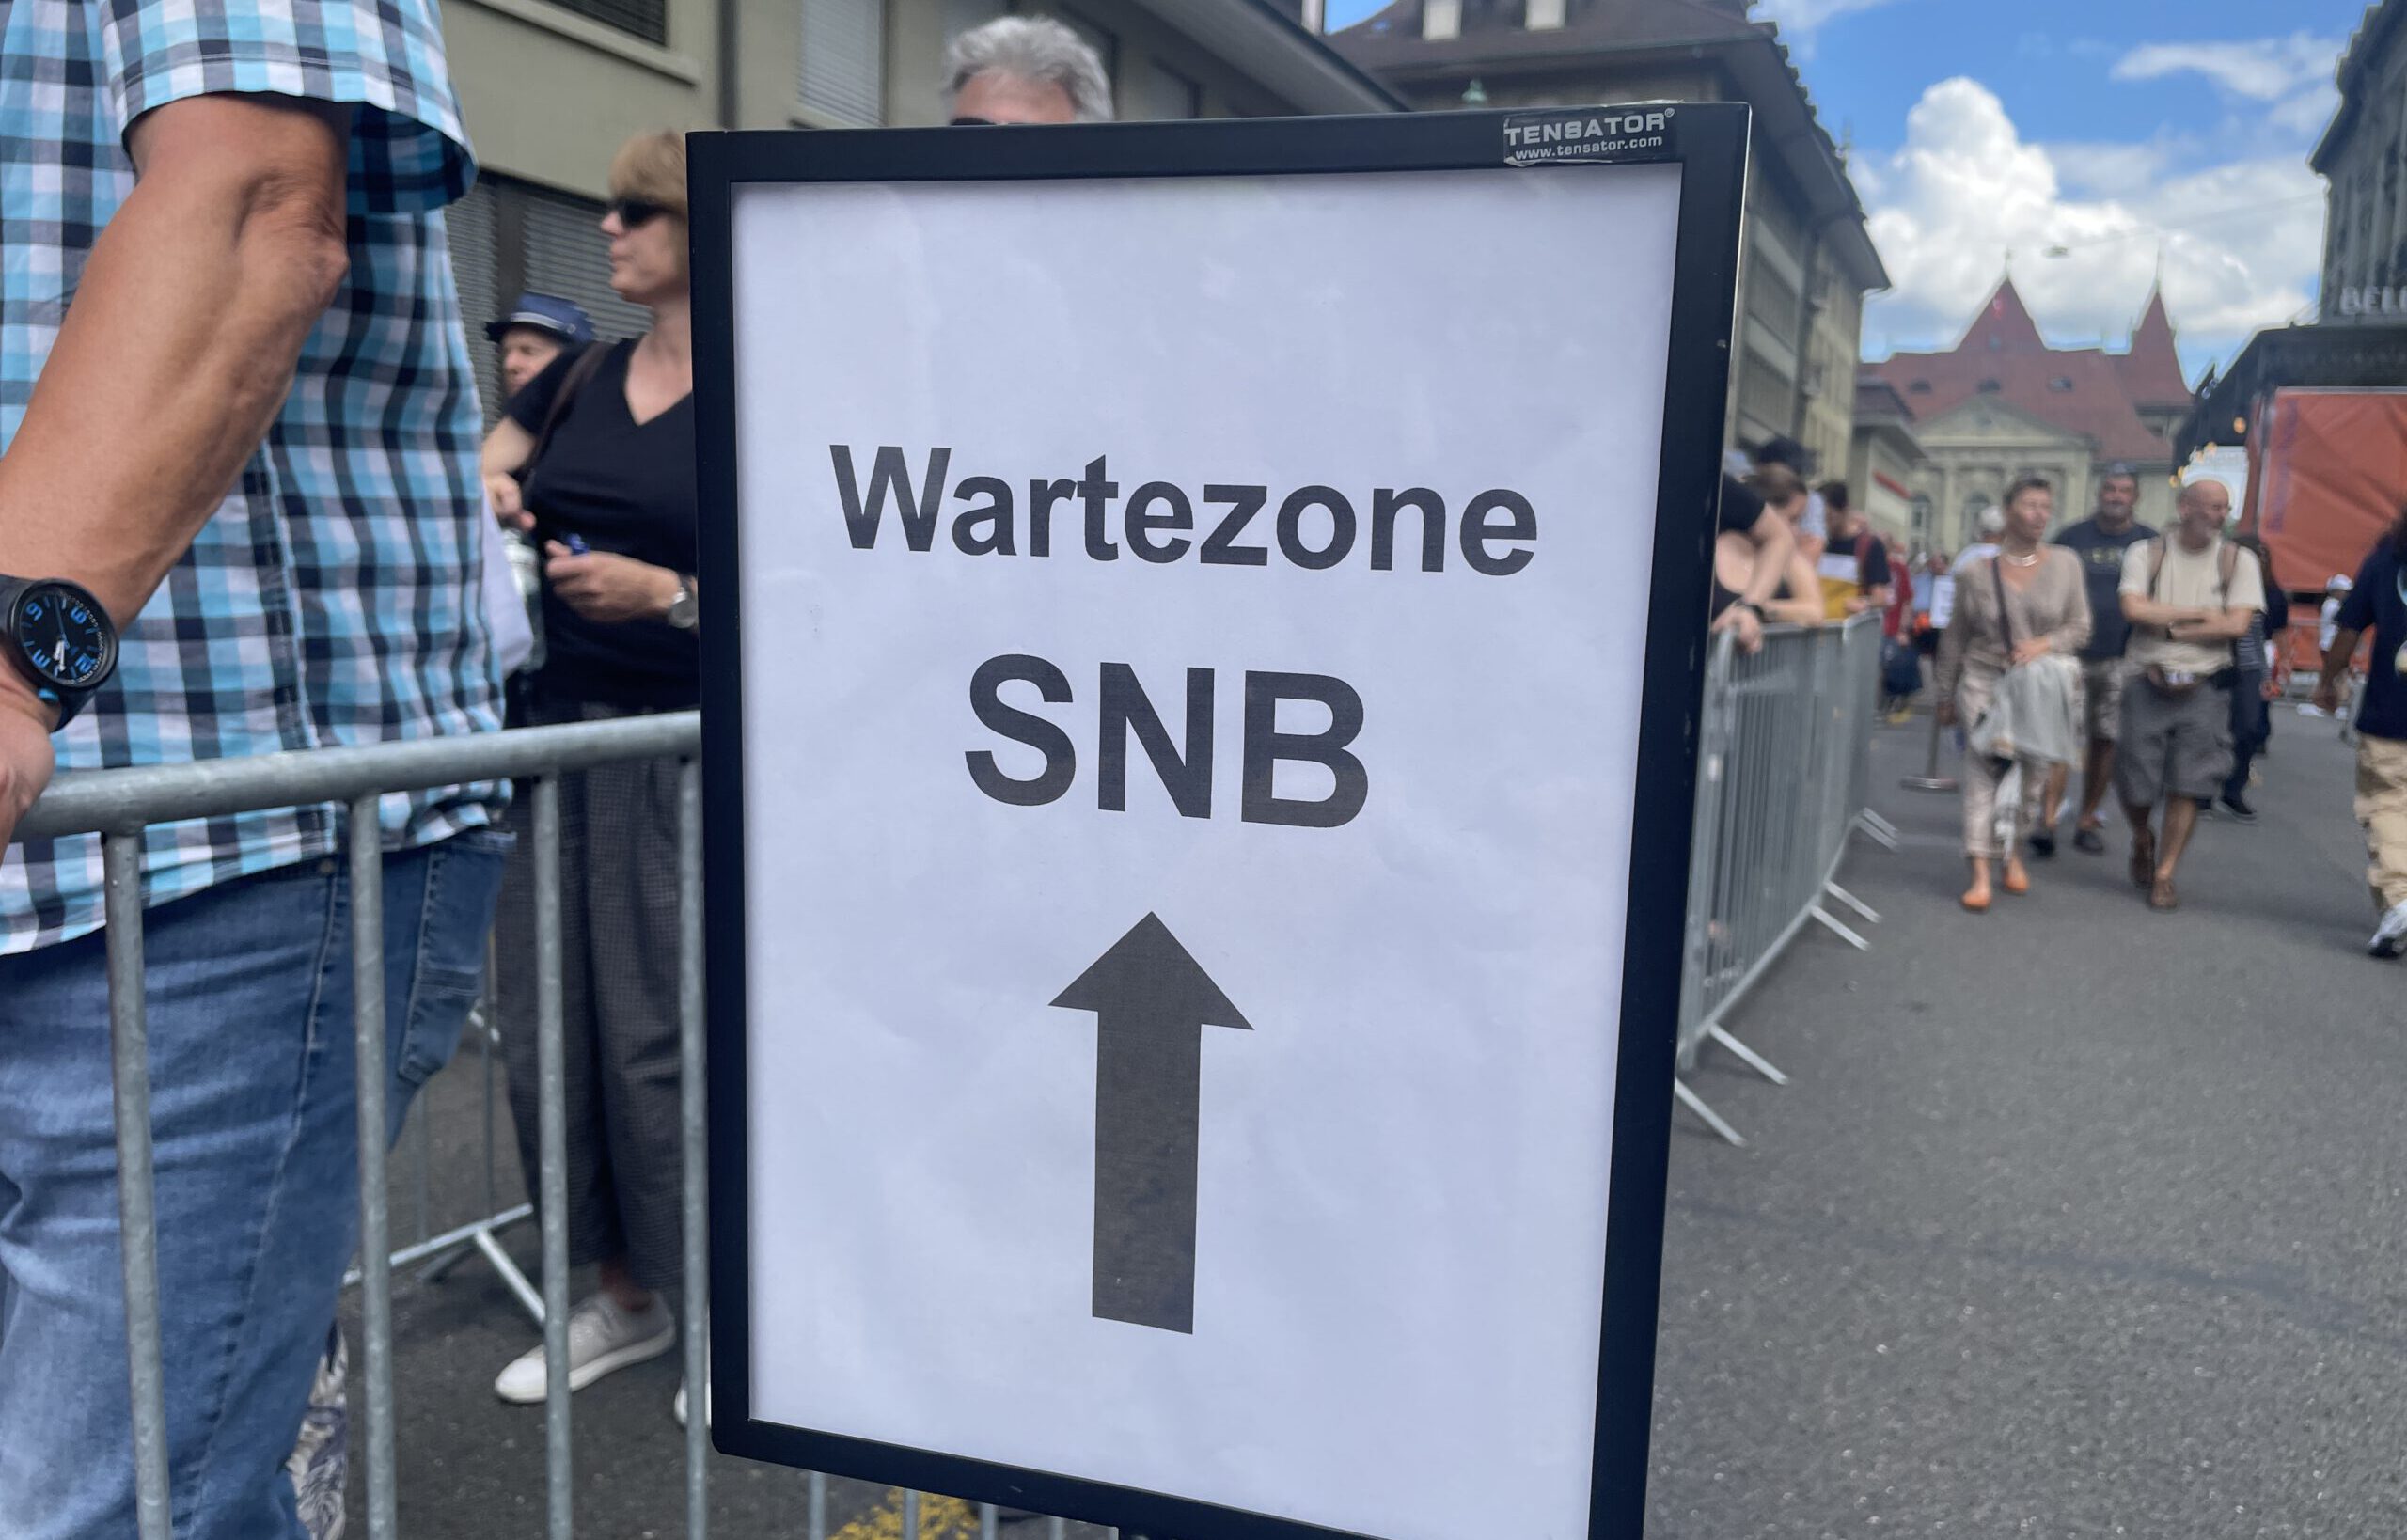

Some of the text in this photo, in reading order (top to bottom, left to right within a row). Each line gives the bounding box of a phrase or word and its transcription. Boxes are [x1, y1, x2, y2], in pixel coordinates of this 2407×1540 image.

[1515, 136, 1662, 160] www.tensator.com
[829, 444, 1537, 576] Wartezone
[964, 653, 1368, 827] SNB
